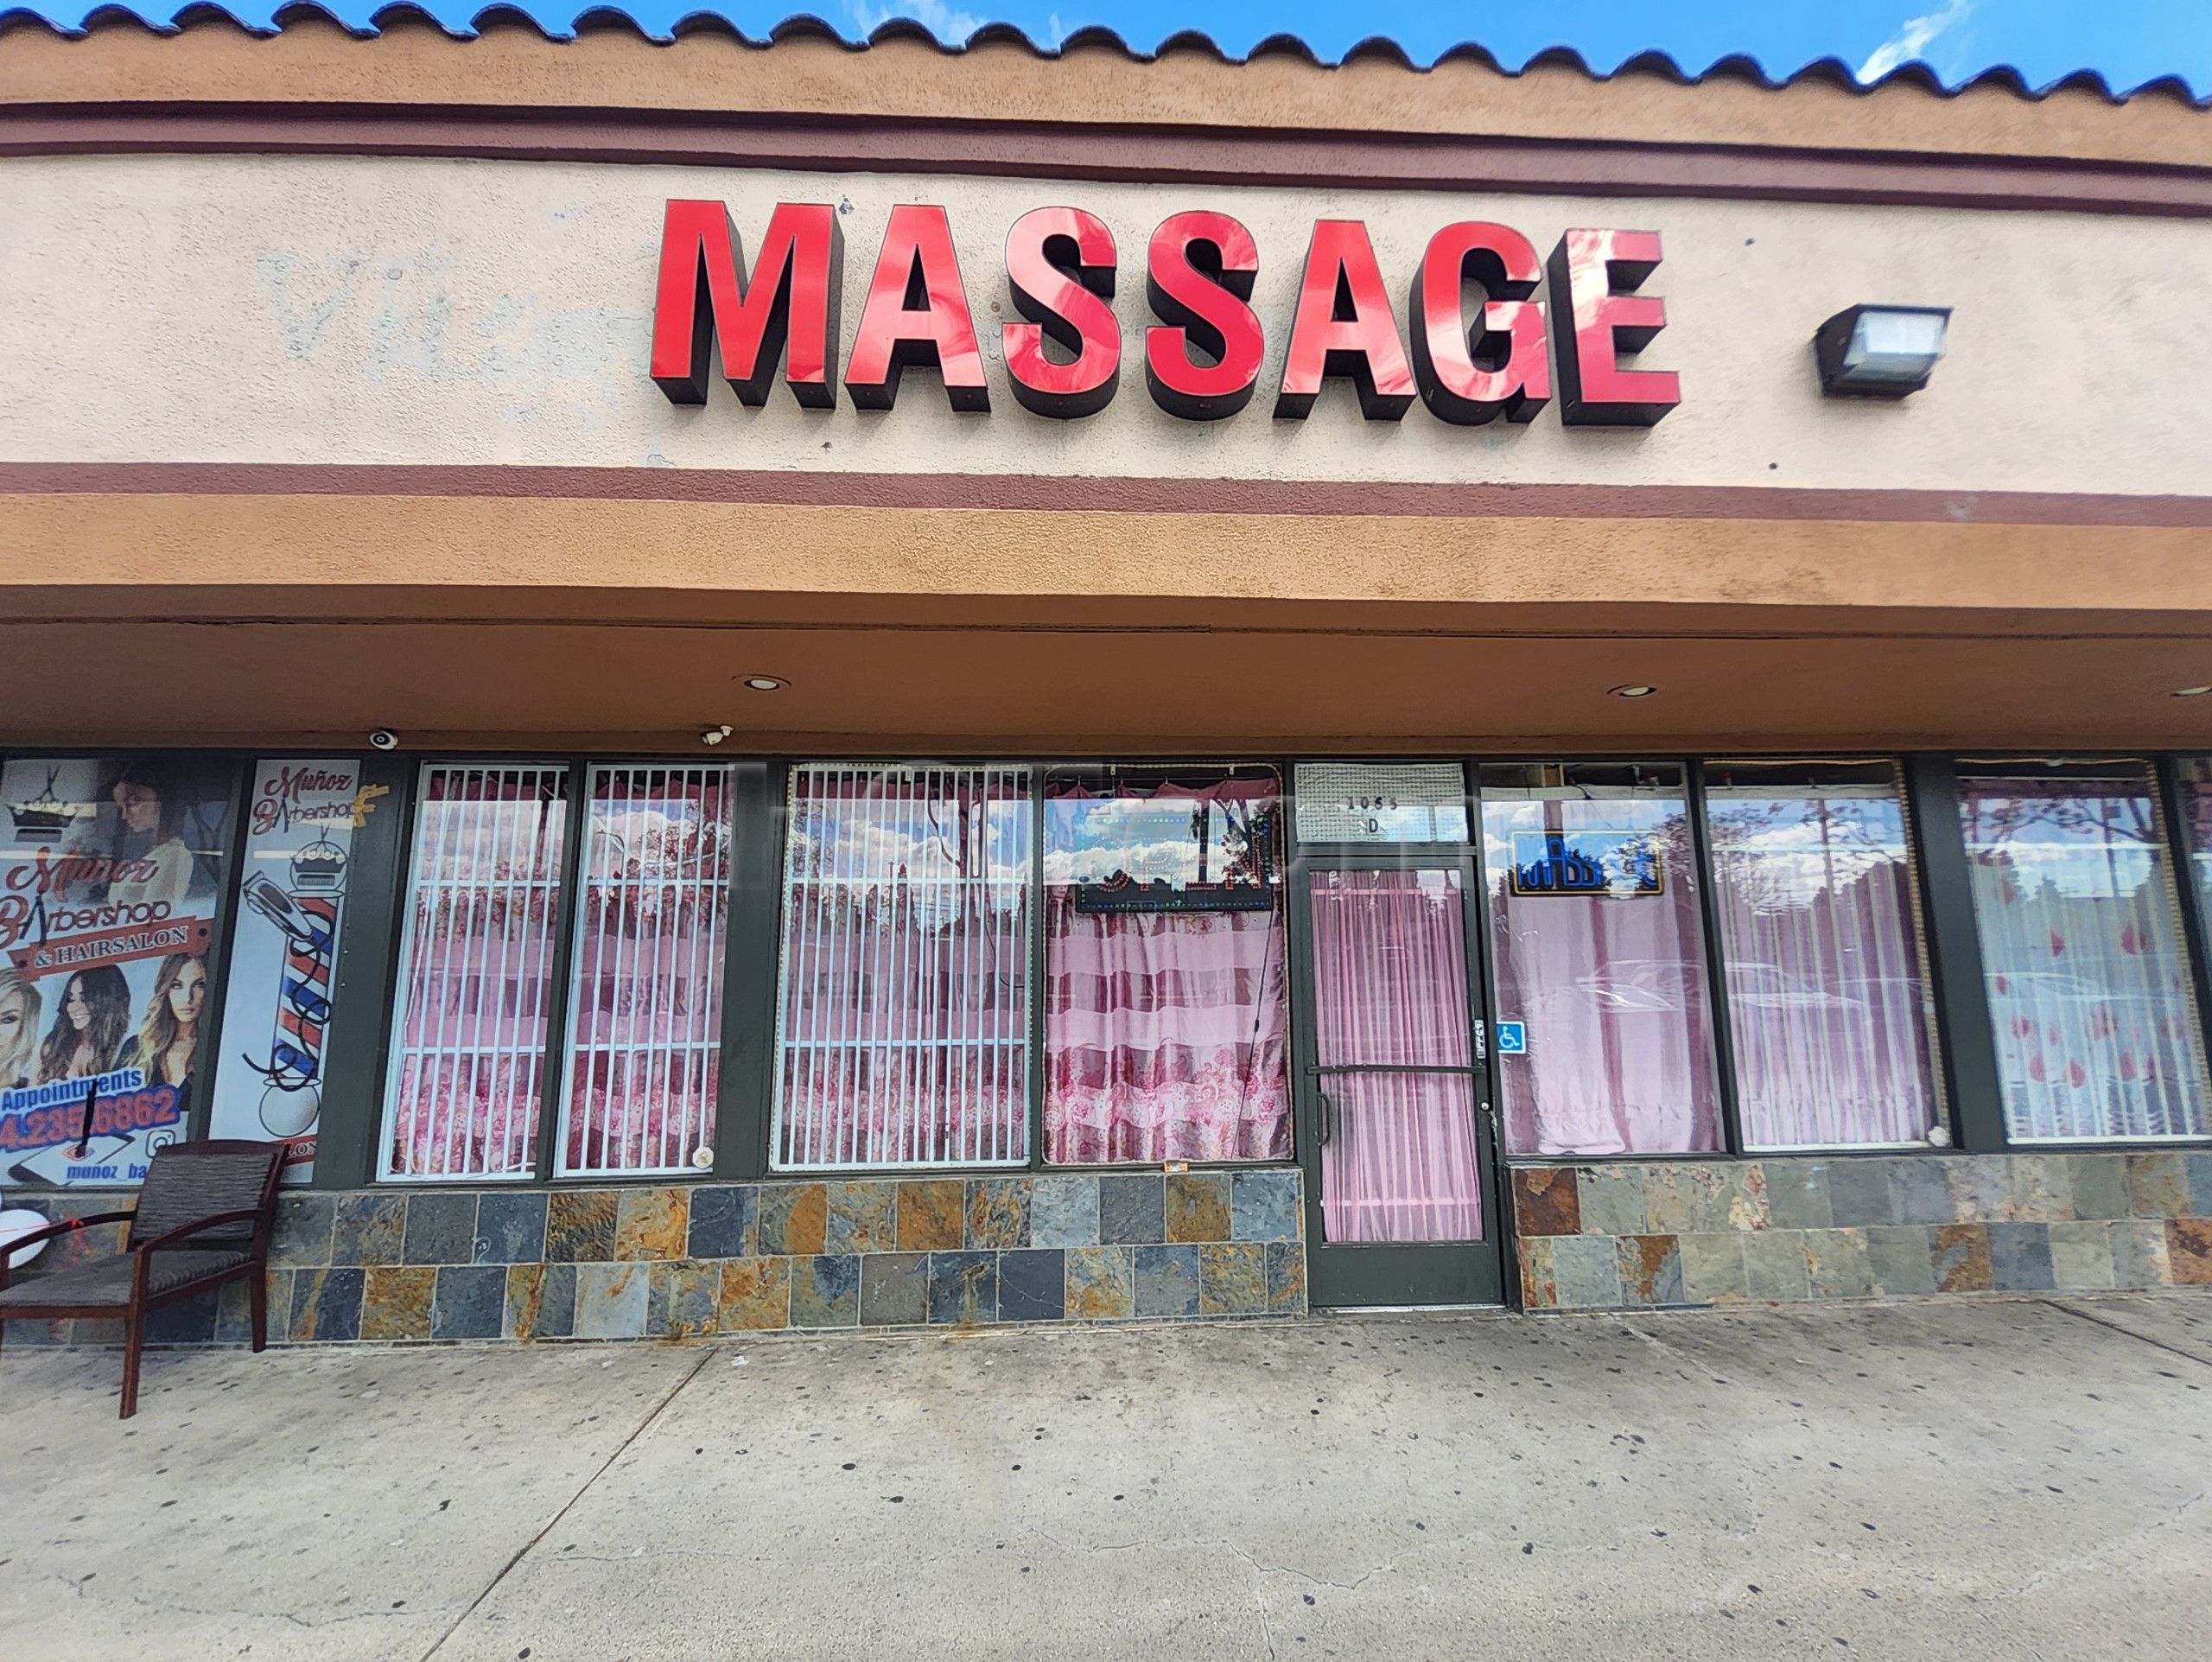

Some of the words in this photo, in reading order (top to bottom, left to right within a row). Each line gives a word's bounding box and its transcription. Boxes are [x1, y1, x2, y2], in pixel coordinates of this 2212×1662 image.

[651, 197, 1681, 415] MASSAGE
[1368, 818, 1379, 834] D
[35, 951, 53, 968] &
[57, 926, 190, 965] HAIRSALON
[2, 1069, 143, 1111] Appointments
